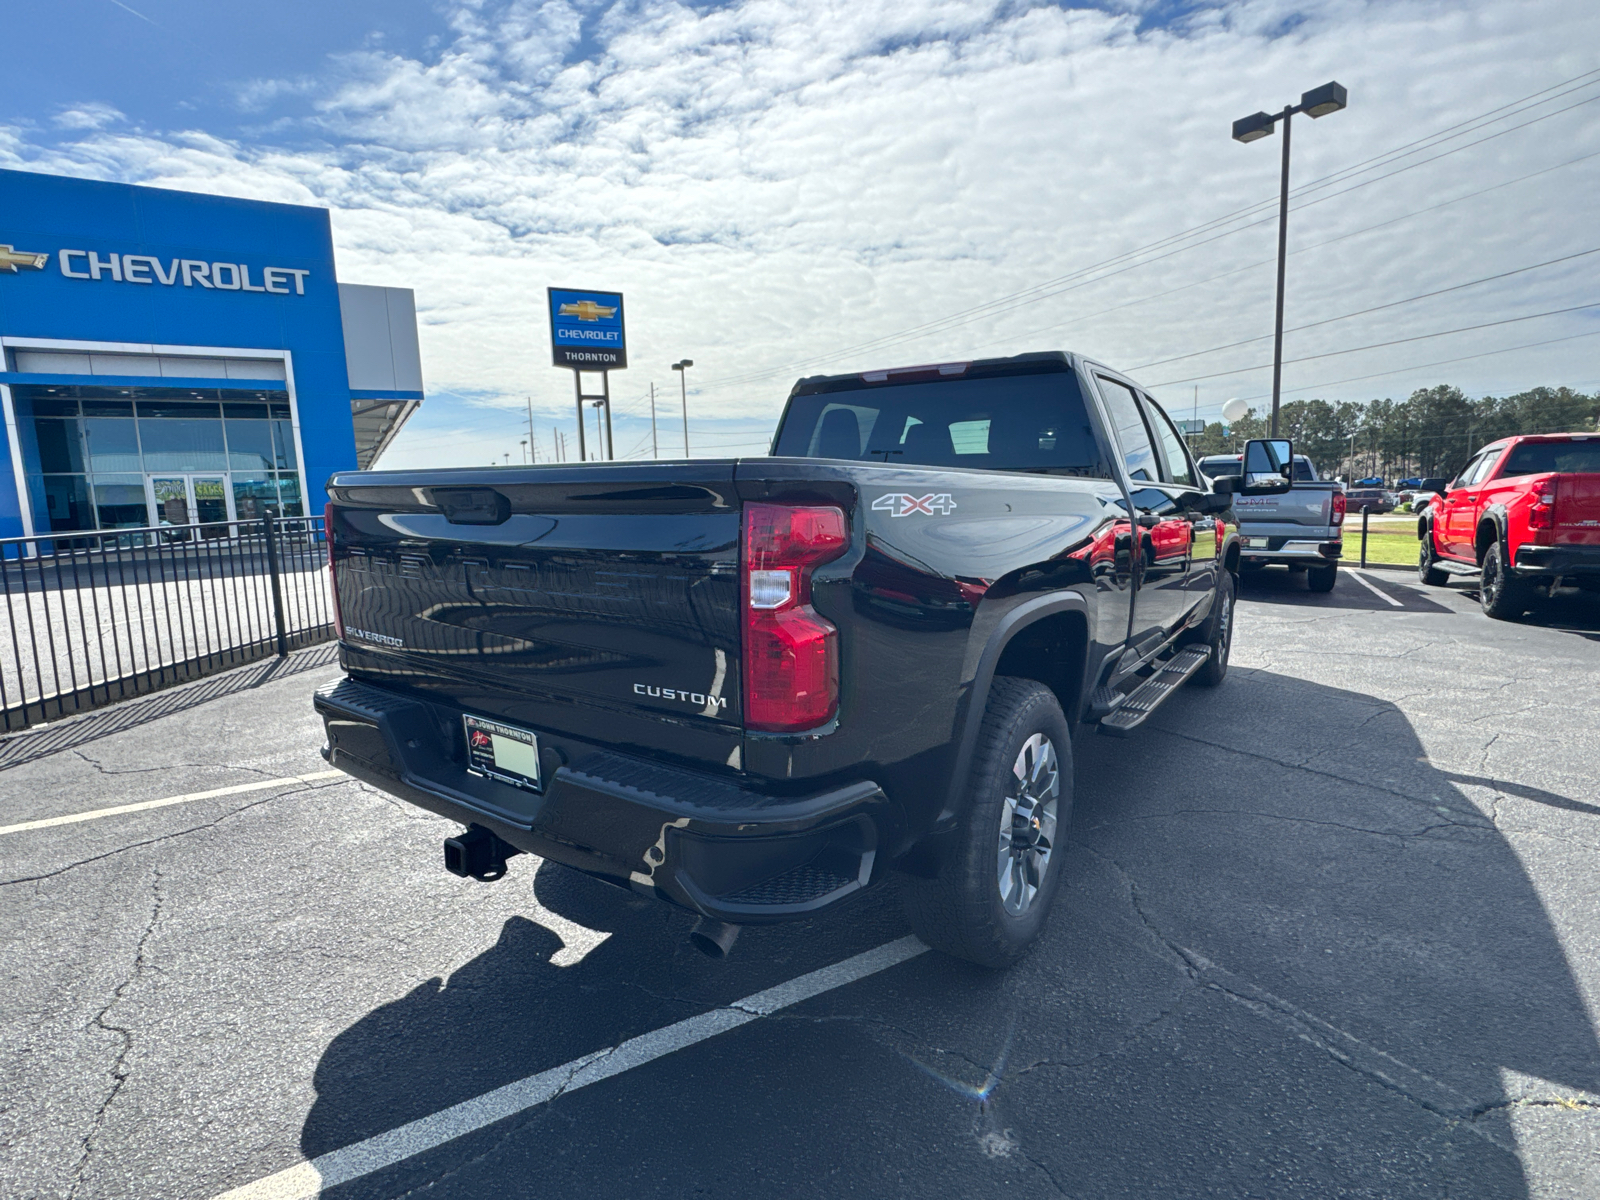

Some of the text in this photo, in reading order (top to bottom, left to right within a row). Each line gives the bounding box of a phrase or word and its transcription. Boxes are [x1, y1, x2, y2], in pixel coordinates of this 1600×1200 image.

[58, 248, 310, 296] CHEVROLET
[558, 328, 620, 341] CHEVROLET
[565, 351, 617, 362] THORNTON
[345, 626, 403, 647] SILVERADO
[633, 683, 727, 708] CUSTOM
[479, 721, 496, 731] JOHN
[496, 726, 532, 741] THORNTON
